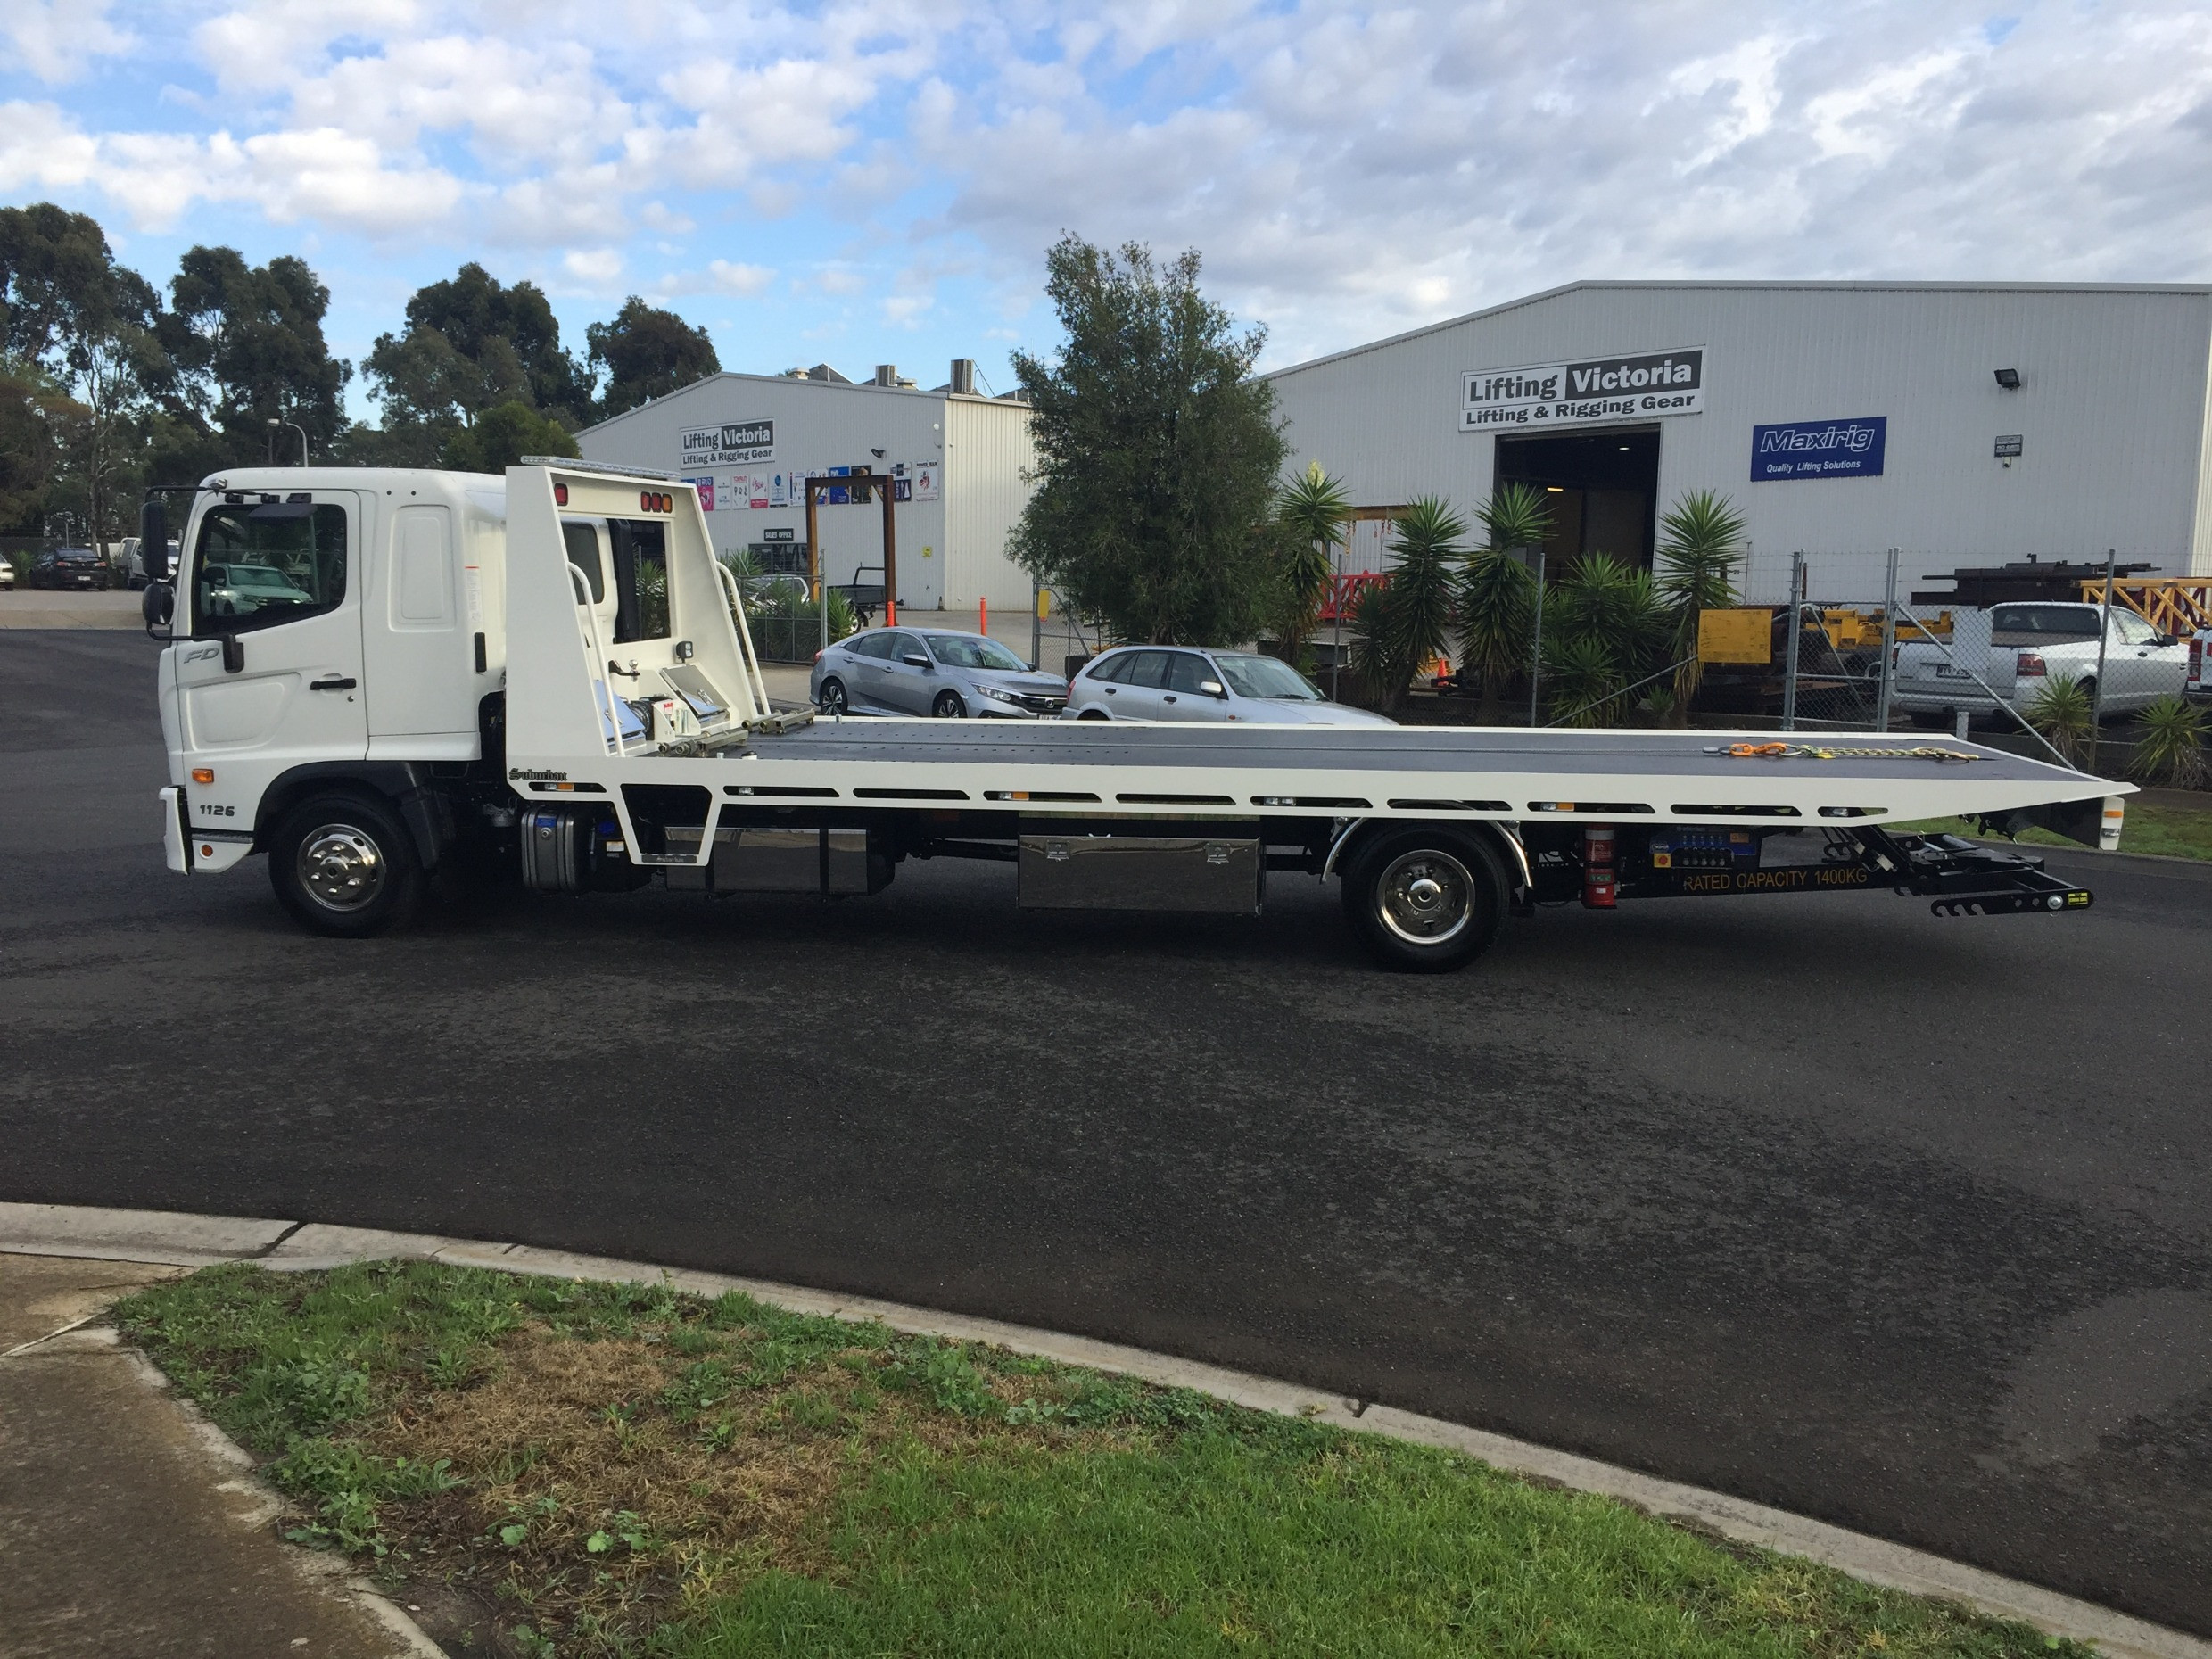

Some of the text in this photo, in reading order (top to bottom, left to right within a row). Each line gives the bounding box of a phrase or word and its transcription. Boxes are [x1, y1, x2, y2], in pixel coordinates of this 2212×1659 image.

[1469, 359, 1692, 403] Lifting Victoria
[1466, 393, 1696, 425] Lifting & Rigging Gear
[683, 425, 771, 450] Lifting Victoria
[1760, 425, 1876, 453] Maxirig
[683, 449, 772, 465] Lifting & Rigging Gear
[1766, 459, 1861, 474] Quality Lifting Solutions
[778, 531, 792, 539] OFFICE
[183, 647, 219, 664] FD
[508, 767, 568, 781] Suburban
[200, 804, 235, 817] 1126
[1684, 868, 1868, 891] RATED CAPACITY 1400KG
